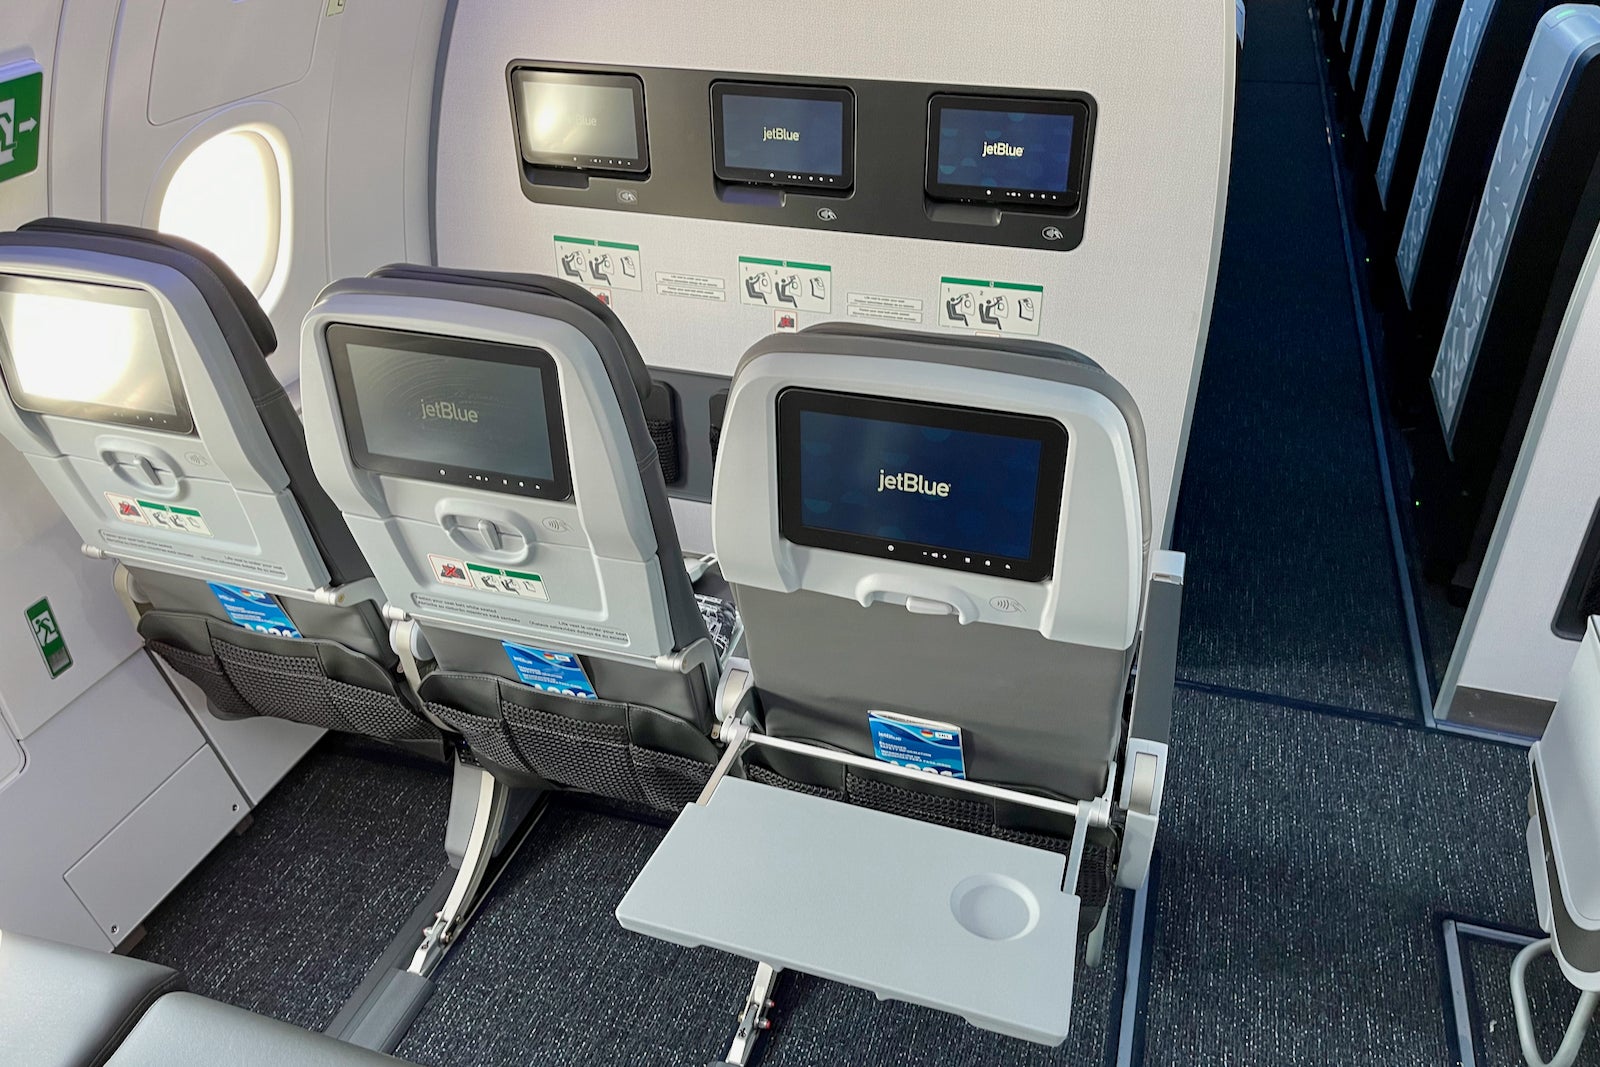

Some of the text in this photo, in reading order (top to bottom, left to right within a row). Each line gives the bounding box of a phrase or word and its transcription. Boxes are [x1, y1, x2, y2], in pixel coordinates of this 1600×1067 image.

[763, 126, 800, 142] jetBlue
[982, 141, 1024, 158] jetBlue
[420, 398, 479, 423] jetBlue
[877, 469, 951, 498] jetBlue
